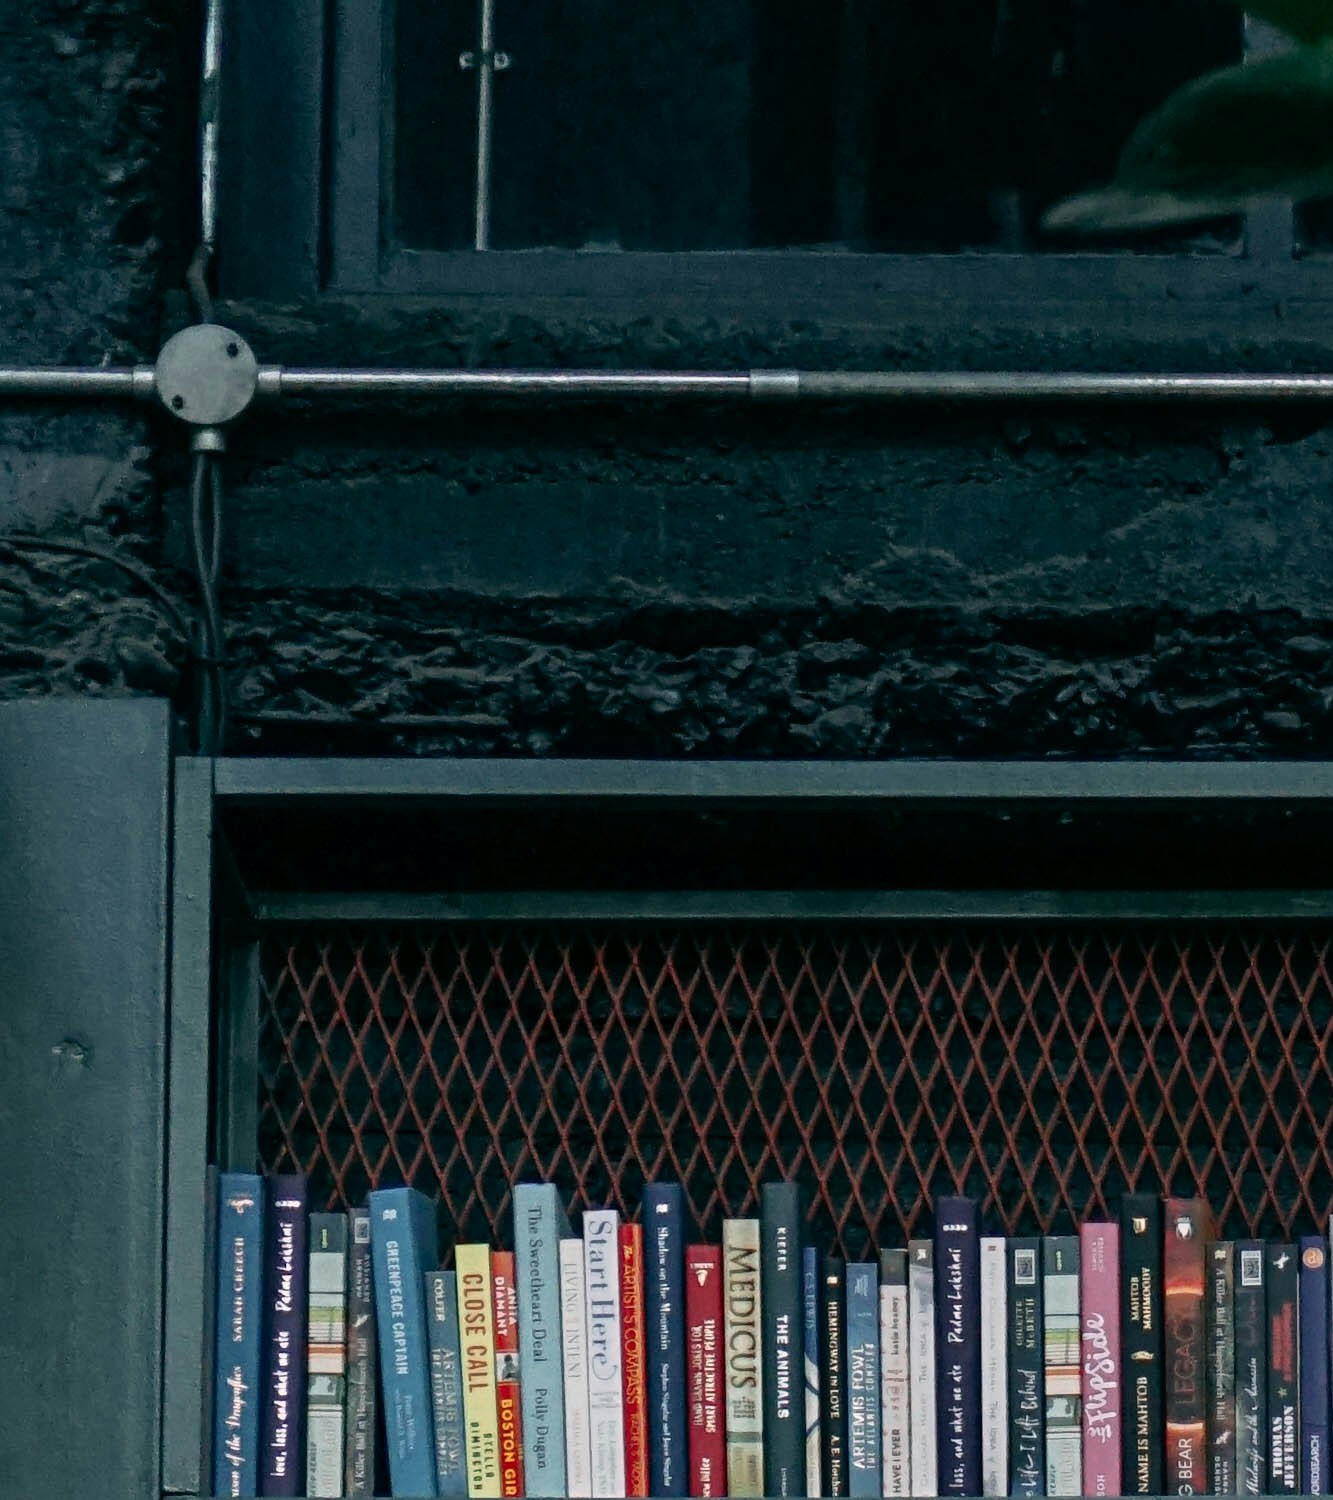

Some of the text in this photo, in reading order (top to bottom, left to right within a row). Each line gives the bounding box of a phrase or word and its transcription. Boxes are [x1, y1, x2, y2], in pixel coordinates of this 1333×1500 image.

[385, 1241, 409, 1374] GREENPEACE CAPTAIN
[526, 1207, 547, 1361] The Sweetheart Deal
[588, 1221, 616, 1365] Start Here
[778, 1227, 786, 1271] KIEFER
[462, 1274, 489, 1392] CLOSE CALL
[729, 1244, 757, 1389] MEDICUS
[777, 1315, 789, 1418] THE ANIMALS
[828, 1301, 840, 1419] HEMINGWAY IN LOVE
[501, 1400, 516, 1463] BOSTON
[1272, 1417, 1282, 1477] THOMAS
[1284, 1405, 1295, 1488] JEFFERSON
